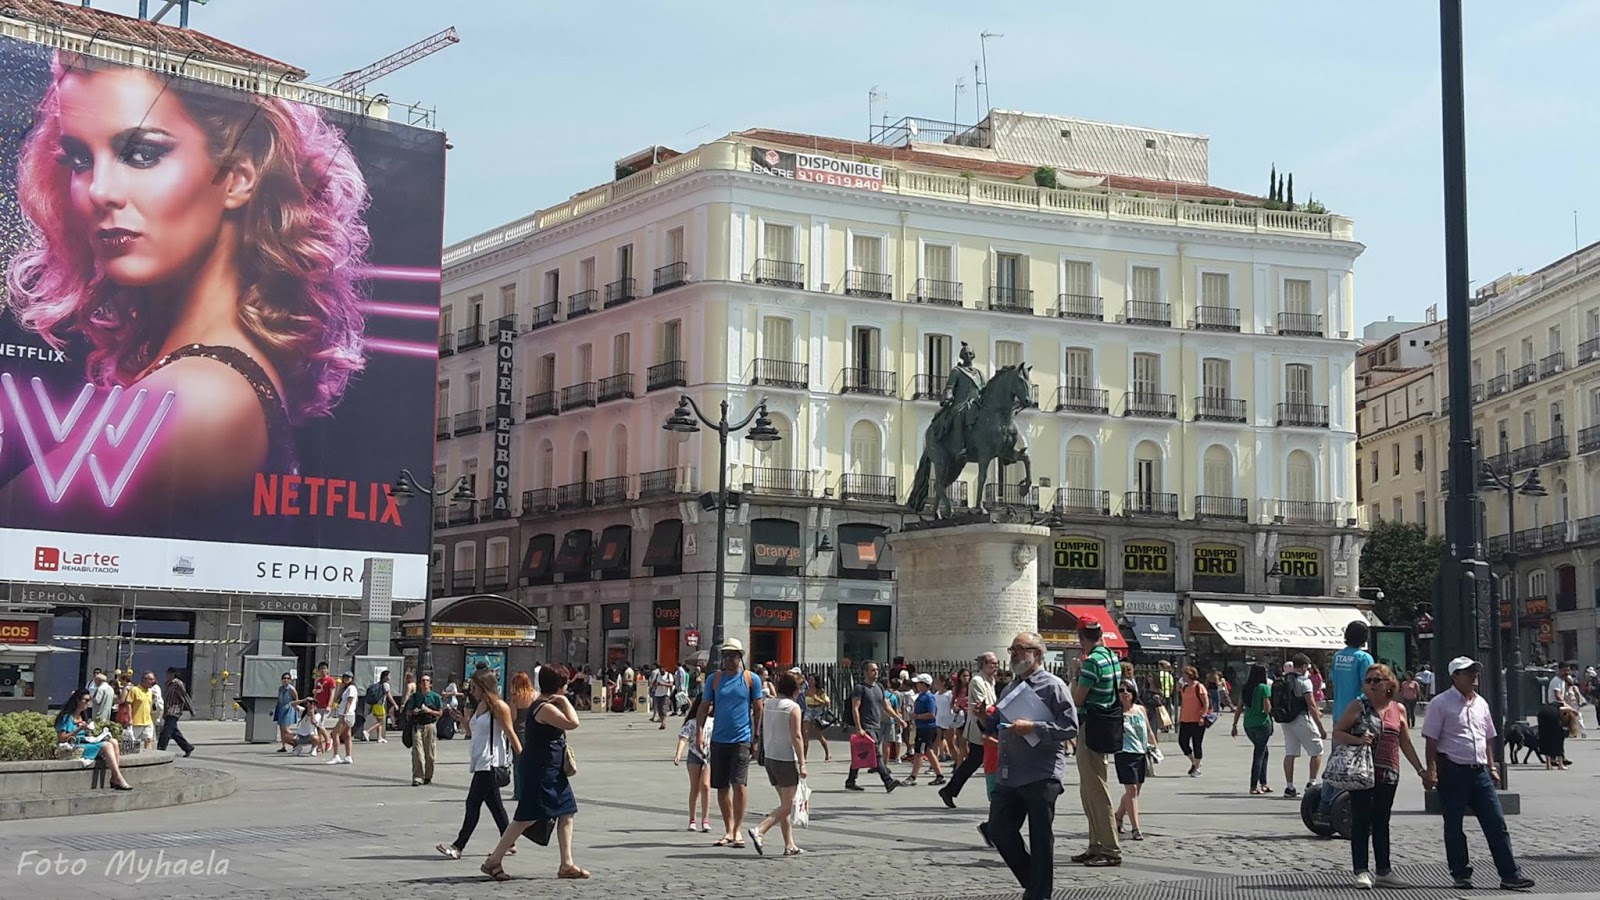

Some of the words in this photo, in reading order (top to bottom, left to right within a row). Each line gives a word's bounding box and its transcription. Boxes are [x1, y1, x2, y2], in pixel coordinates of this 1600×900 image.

[799, 155, 879, 178] DISPONIBLE
[798, 170, 824, 183] 910
[827, 174, 852, 188] 619
[854, 179, 880, 191] 840
[499, 330, 514, 406] HOTEL
[494, 417, 510, 510] EUROPA
[253, 472, 403, 527] NETFLIX
[755, 544, 801, 559] Orange
[1054, 541, 1099, 551] COMPRO
[1124, 545, 1167, 555] COMPRO
[1194, 548, 1237, 558] COMPRO
[63, 551, 120, 567] Lartec
[1054, 551, 1098, 568] ORO
[1124, 554, 1167, 571] ORO
[1279, 551, 1317, 560] COMPRO
[1194, 558, 1237, 574] ORO
[1280, 560, 1318, 577] ORO
[655, 607, 680, 619] Orange
[754, 606, 793, 621] Orange
[0, 626, 30, 637] COS
[1214, 622, 1281, 635] CASA
[1298, 626, 1347, 637] DIE
